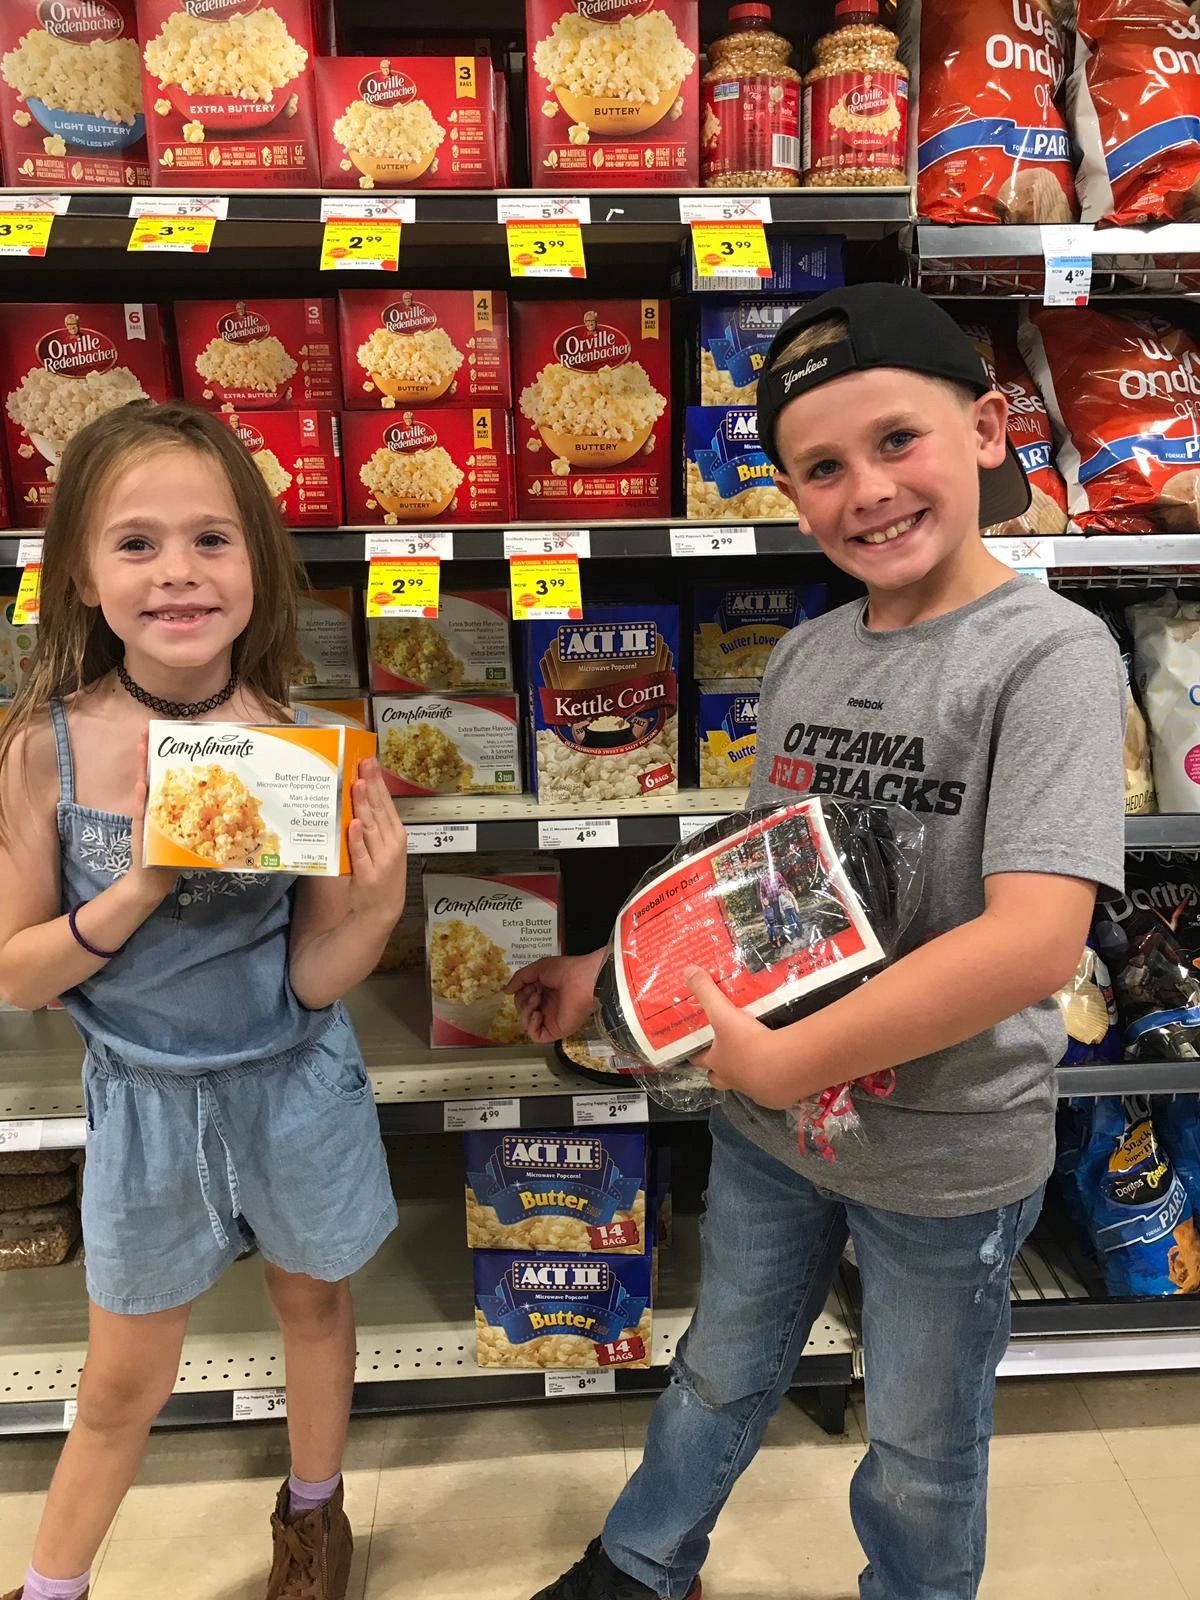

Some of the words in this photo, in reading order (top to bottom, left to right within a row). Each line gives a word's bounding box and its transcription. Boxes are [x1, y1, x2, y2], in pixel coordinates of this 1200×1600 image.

[50, 0, 106, 22] Orville
[44, 17, 122, 36] Redenbacher
[459, 66, 471, 80] 3
[367, 75, 405, 94] Orville
[363, 85, 416, 105] Redenbacher
[851, 89, 883, 105] Orville
[190, 105, 225, 114] EXTRA
[228, 103, 276, 113] BUTTERY
[594, 107, 641, 116] BUTTERY
[54, 121, 85, 132] LIGHT
[87, 124, 132, 136] BUTTERY
[376, 163, 409, 171] BUTTERY
[476, 297, 489, 311] 4
[128, 311, 141, 324] 6
[307, 305, 320, 319] 3
[390, 306, 426, 323] Orville
[644, 307, 655, 320] 8
[224, 314, 259, 333] Orville
[385, 314, 437, 333] Redenbacher
[221, 323, 271, 342] Redenbacher
[48, 334, 100, 361] Orville
[565, 331, 616, 355] Orville
[43, 348, 117, 374] Redenbacher
[559, 343, 631, 369] Redenbacher
[781, 355, 828, 393] Yankees
[223, 392, 246, 400] EXTRA
[247, 391, 279, 400] BUTTERY
[397, 385, 429, 393] BUTTERY
[303, 418, 315, 431] 3
[476, 416, 488, 429] 4
[391, 426, 426, 443] Orville
[387, 435, 437, 452] Redenbacher
[575, 443, 617, 451] BUTTERY
[399, 502, 430, 510] BUTTERY
[566, 630, 616, 655] ACT
[619, 628, 649, 652] II
[720, 634, 751, 655] Butter
[752, 632, 781, 647] Lover
[578, 664, 610, 672] Microwave
[611, 662, 637, 672] Popcorn!
[554, 696, 614, 718] Kettle
[617, 683, 667, 710] Corn
[847, 697, 884, 710] Reebok
[382, 704, 452, 724] Compliments
[157, 735, 254, 762] Compliments
[728, 744, 757, 764] Butte
[783, 723, 926, 772] OTTAWA
[256, 781, 288, 789] Microwave
[289, 782, 315, 790] Popping
[275, 773, 299, 782] Butter
[301, 773, 330, 783] Flavour
[644, 774, 655, 788] 6
[302, 809, 329, 818] Saveur
[290, 817, 300, 826] de
[302, 818, 329, 827] beurre
[665, 886, 679, 899] for
[434, 894, 523, 917] Compliments
[502, 919, 524, 927] Extra
[525, 918, 552, 927] Butter
[520, 927, 552, 935] Flavour
[510, 1143, 559, 1165] ACT
[564, 1145, 594, 1164] II
[525, 1171, 555, 1180] Microwave
[556, 1172, 582, 1181] Popcorn!
[1115, 1178, 1145, 1198] Doritos
[519, 1189, 589, 1211] Butter
[597, 1223, 623, 1238] 14
[602, 1236, 627, 1247] BAGS
[520, 1267, 567, 1286] ACT
[572, 1267, 601, 1286] II
[534, 1293, 564, 1302] Microwave
[528, 1311, 597, 1332] Butter
[604, 1339, 631, 1355] 14
[609, 1352, 634, 1362] BAGS
